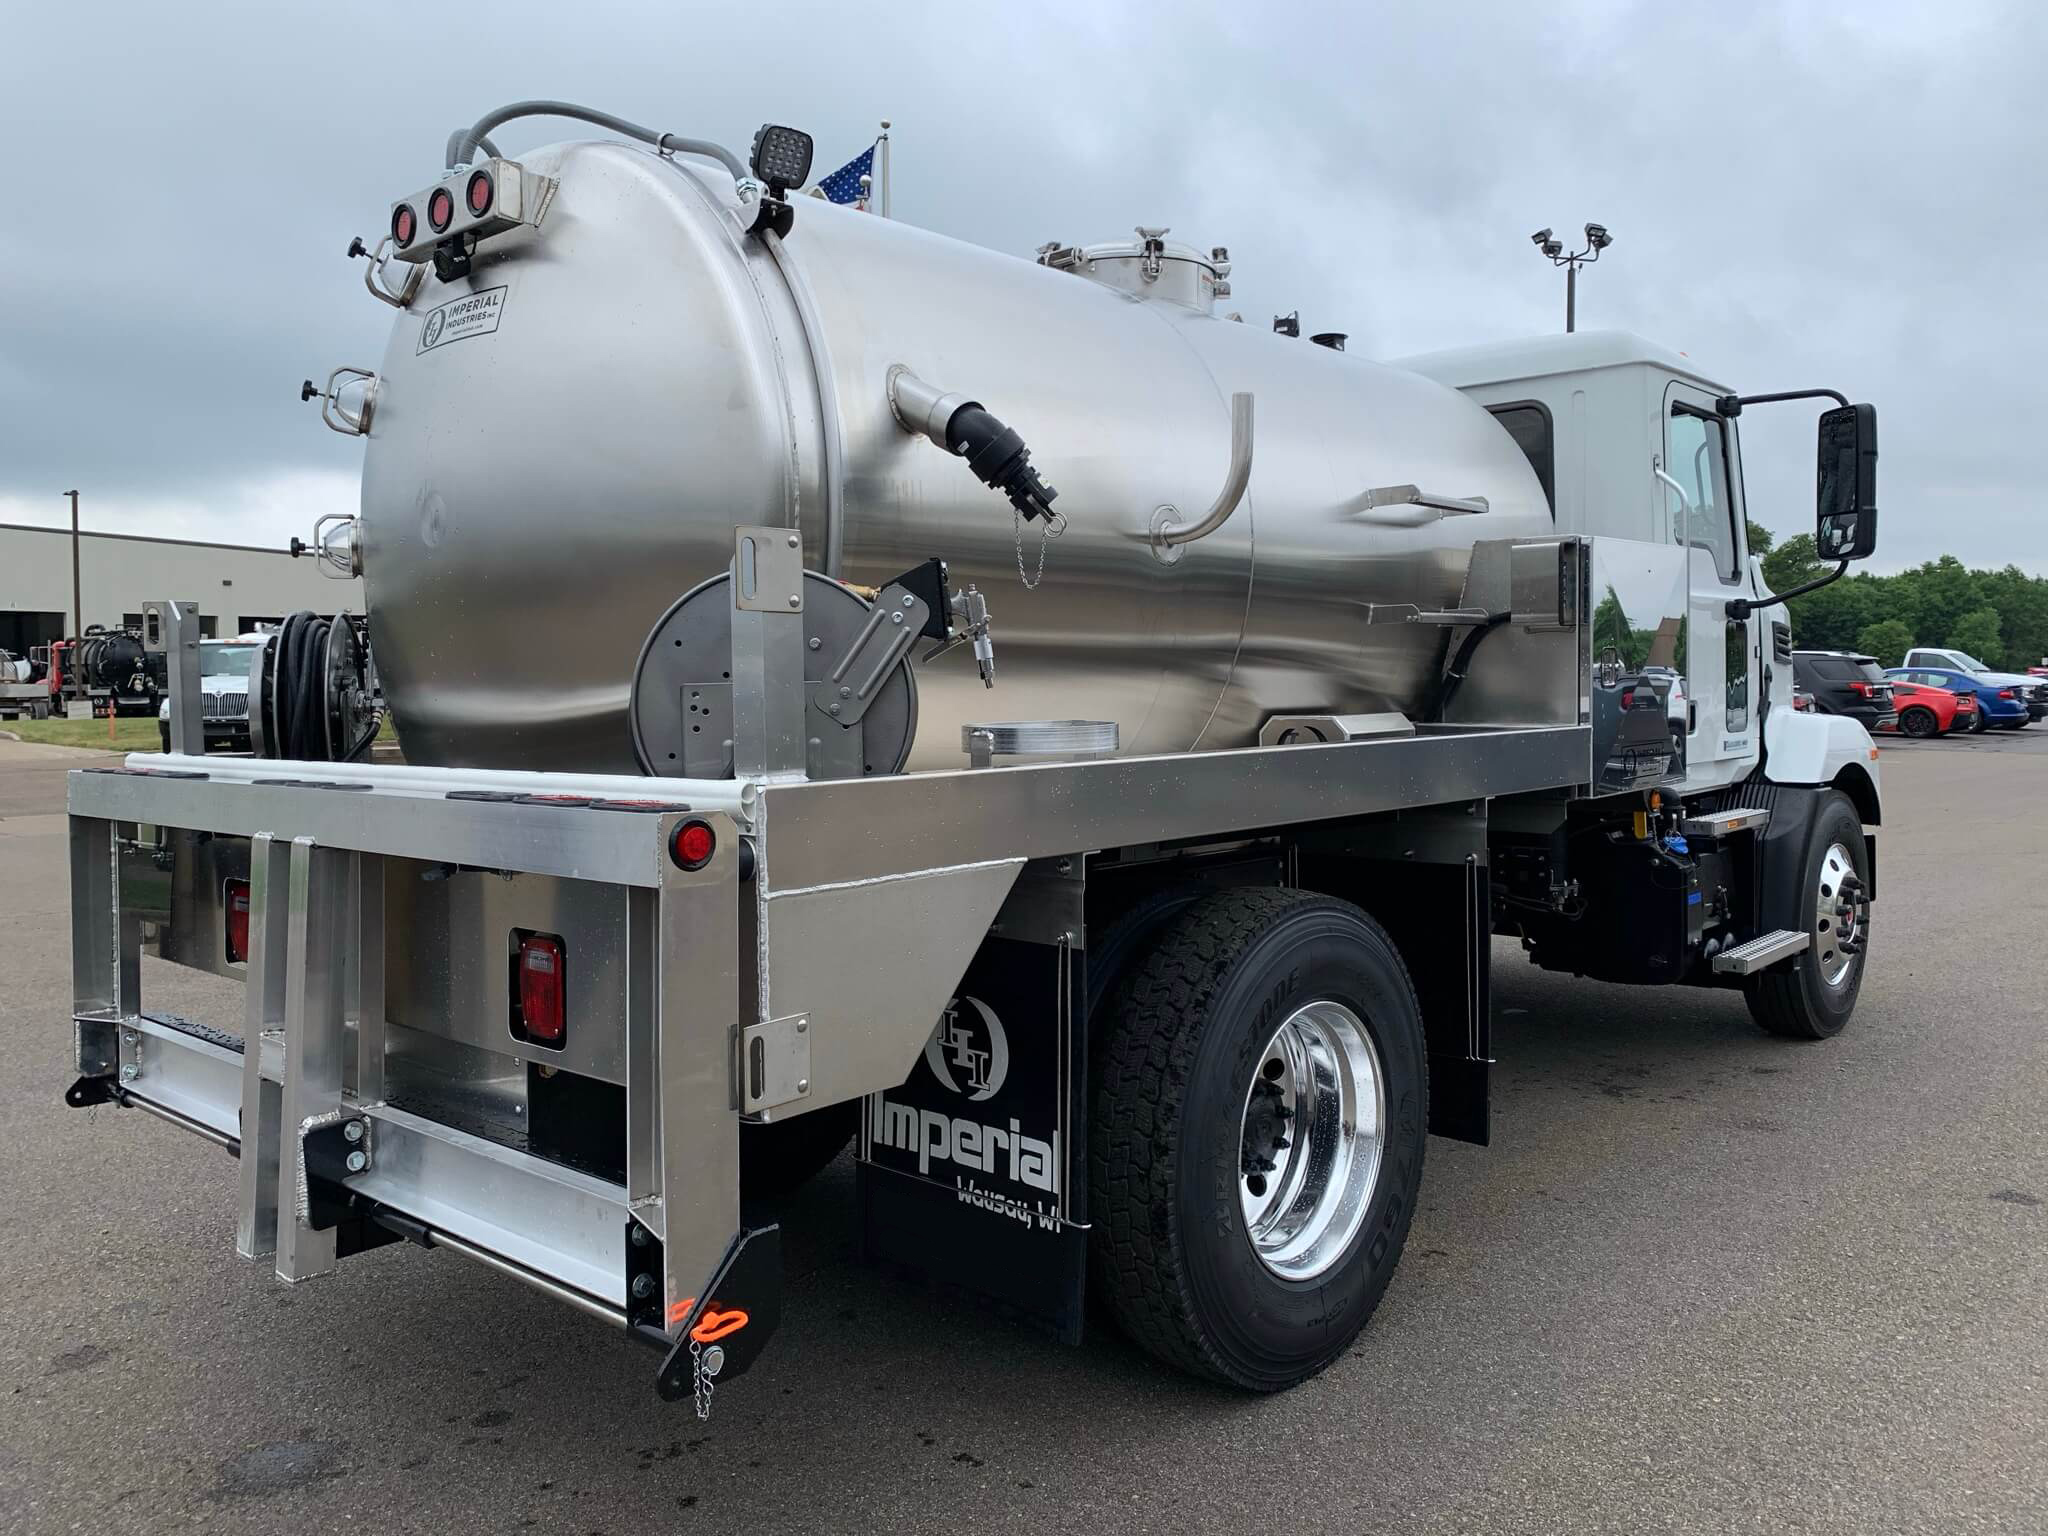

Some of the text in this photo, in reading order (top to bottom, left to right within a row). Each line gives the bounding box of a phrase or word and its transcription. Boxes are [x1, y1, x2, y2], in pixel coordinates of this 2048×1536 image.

[449, 294, 499, 318] IMPERIAL
[445, 311, 487, 330] INDUSTRIES
[873, 1090, 1060, 1194] Imperial
